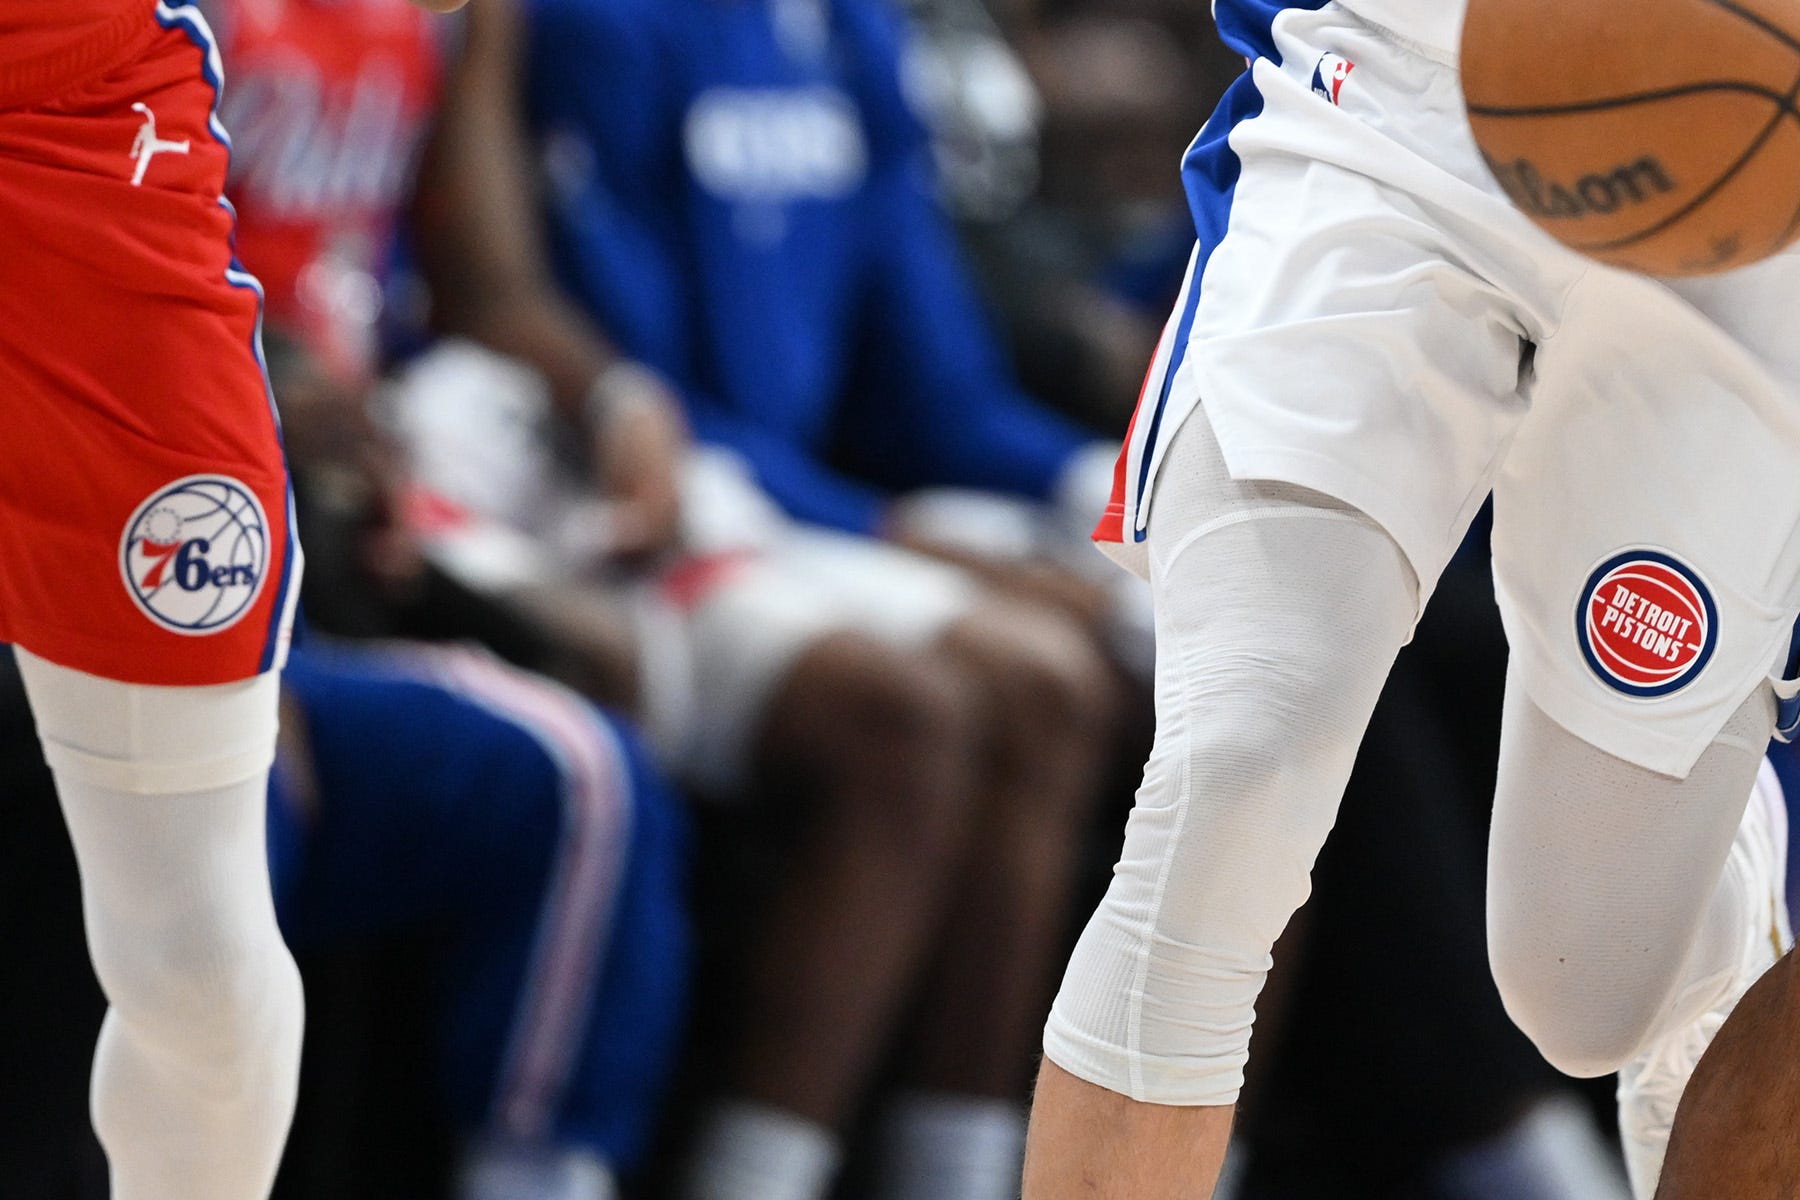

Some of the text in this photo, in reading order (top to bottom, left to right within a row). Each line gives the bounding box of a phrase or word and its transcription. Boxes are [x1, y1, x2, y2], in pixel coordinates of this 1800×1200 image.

[142, 536, 257, 592] 76ers
[1601, 606, 1683, 662] PISTONS
[1612, 584, 1692, 639] DETROIT
